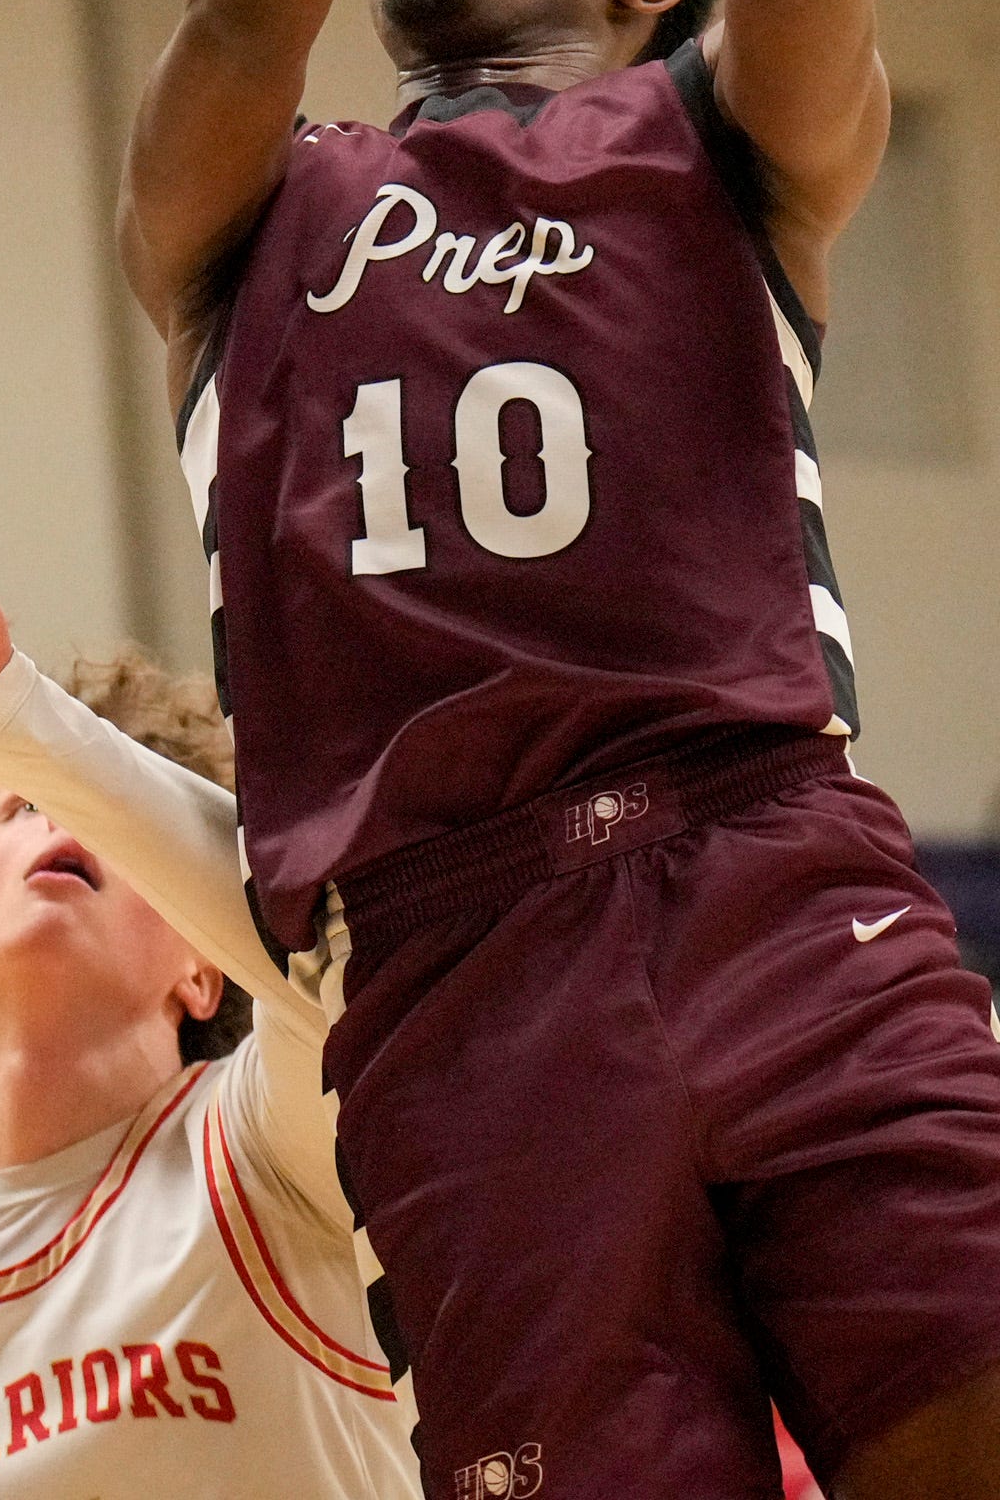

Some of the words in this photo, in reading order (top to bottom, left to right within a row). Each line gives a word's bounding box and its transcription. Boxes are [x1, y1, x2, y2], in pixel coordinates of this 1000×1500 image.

[306, 183, 595, 314] Prep
[342, 361, 594, 576] 10
[565, 782, 649, 846] HPS
